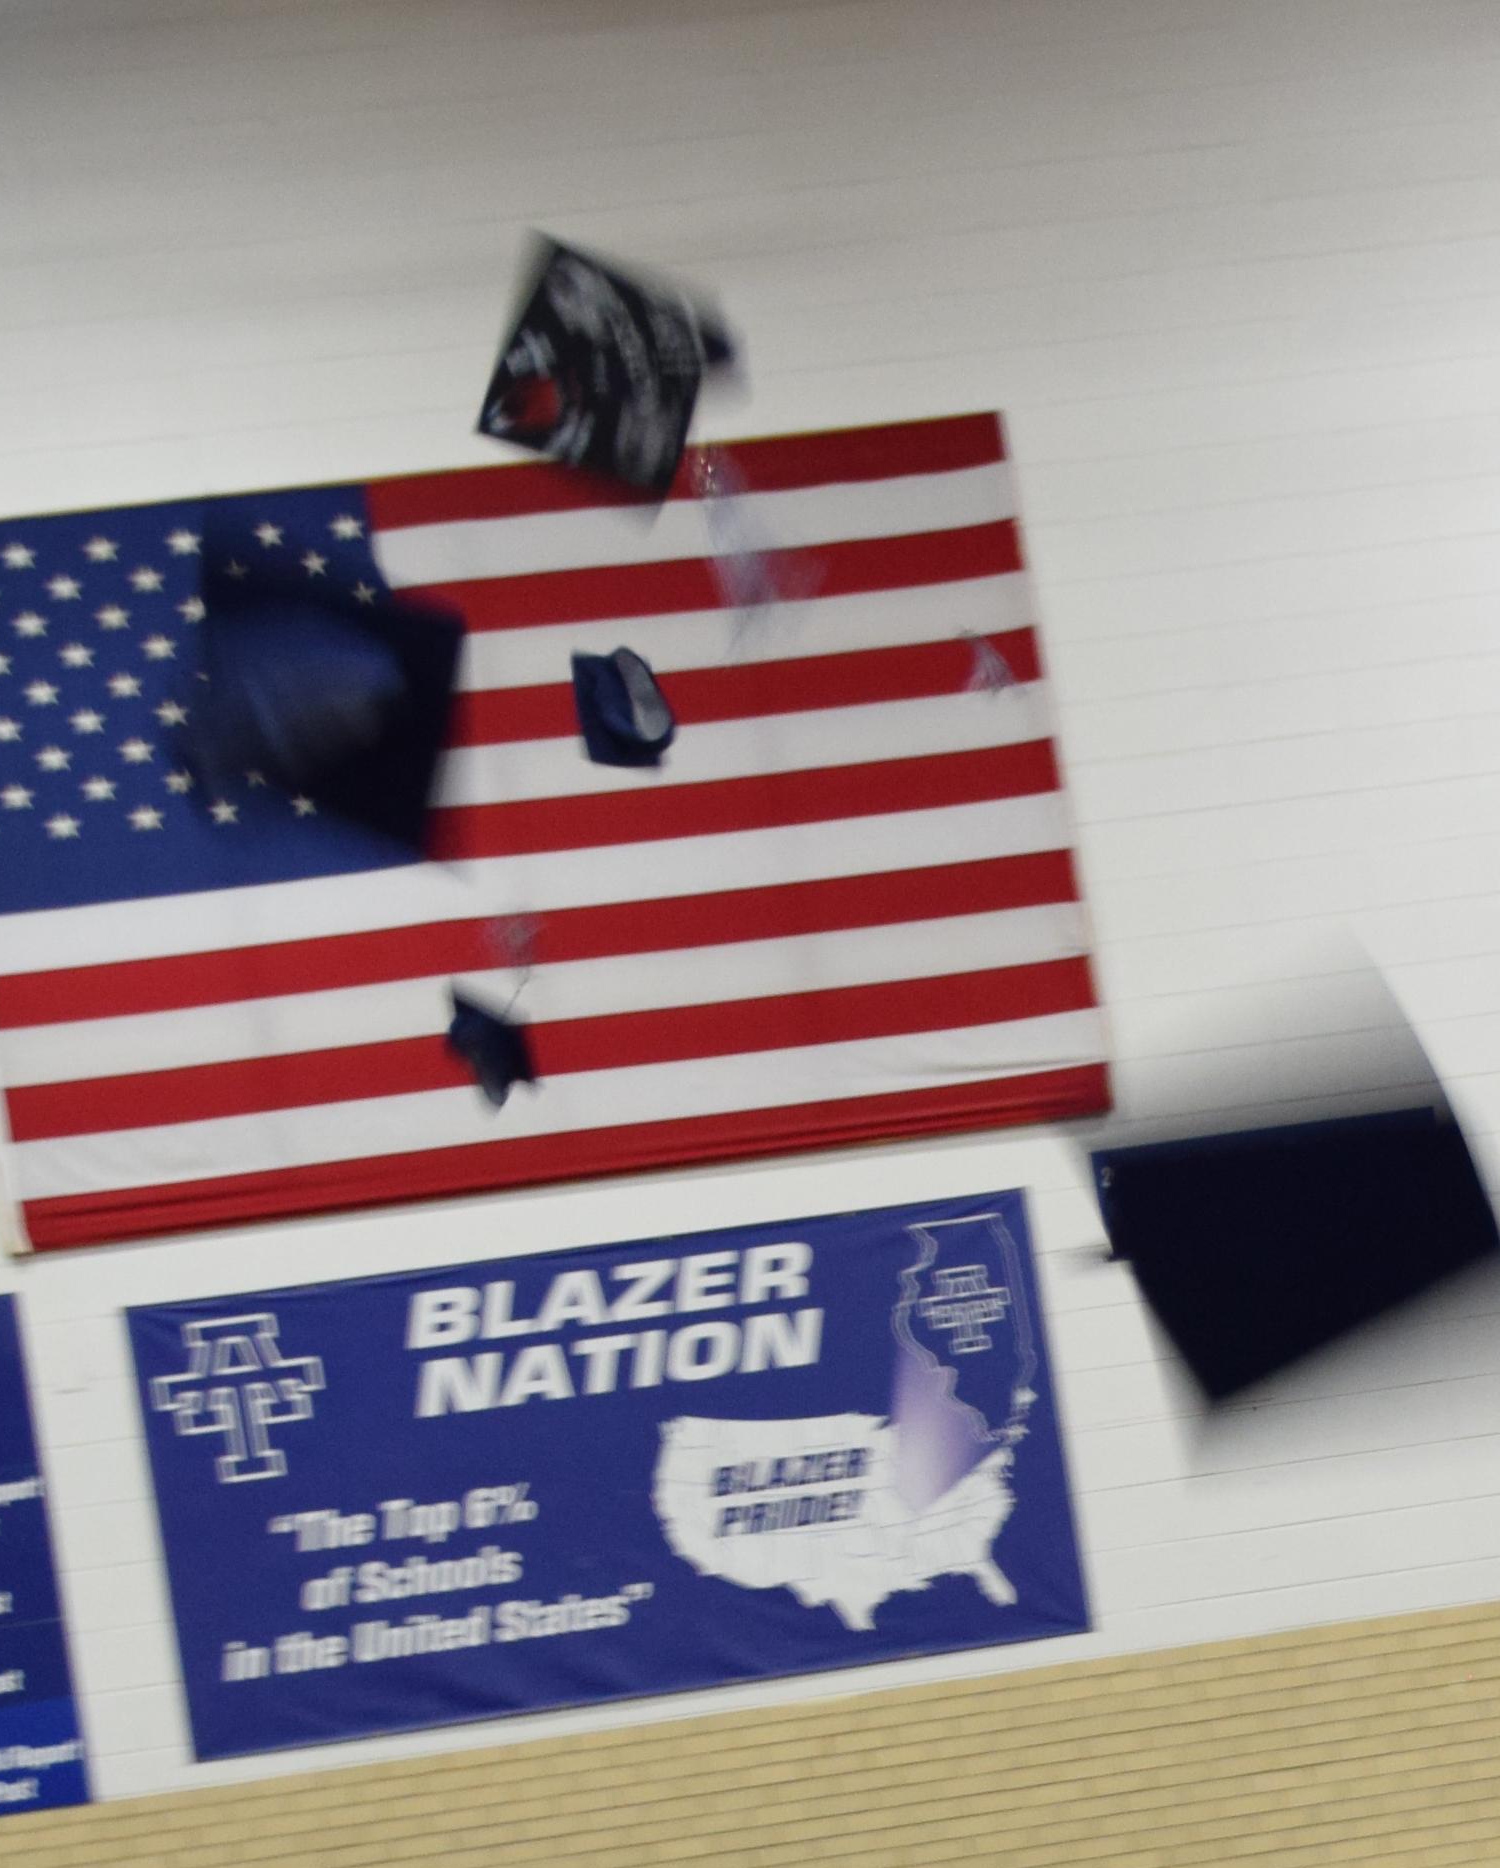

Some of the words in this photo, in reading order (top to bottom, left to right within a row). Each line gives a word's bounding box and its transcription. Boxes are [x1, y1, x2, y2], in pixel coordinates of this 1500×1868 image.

[404, 1242, 814, 1351] BLAZER
[413, 1307, 825, 1419] NATION
[711, 1447, 872, 1498] BLAZER
[379, 1498, 461, 1544] Top
[301, 1566, 355, 1611] of
[353, 1545, 523, 1603] Schools
[221, 1641, 270, 1683] in
[273, 1631, 349, 1676] the
[351, 1605, 493, 1663] United
